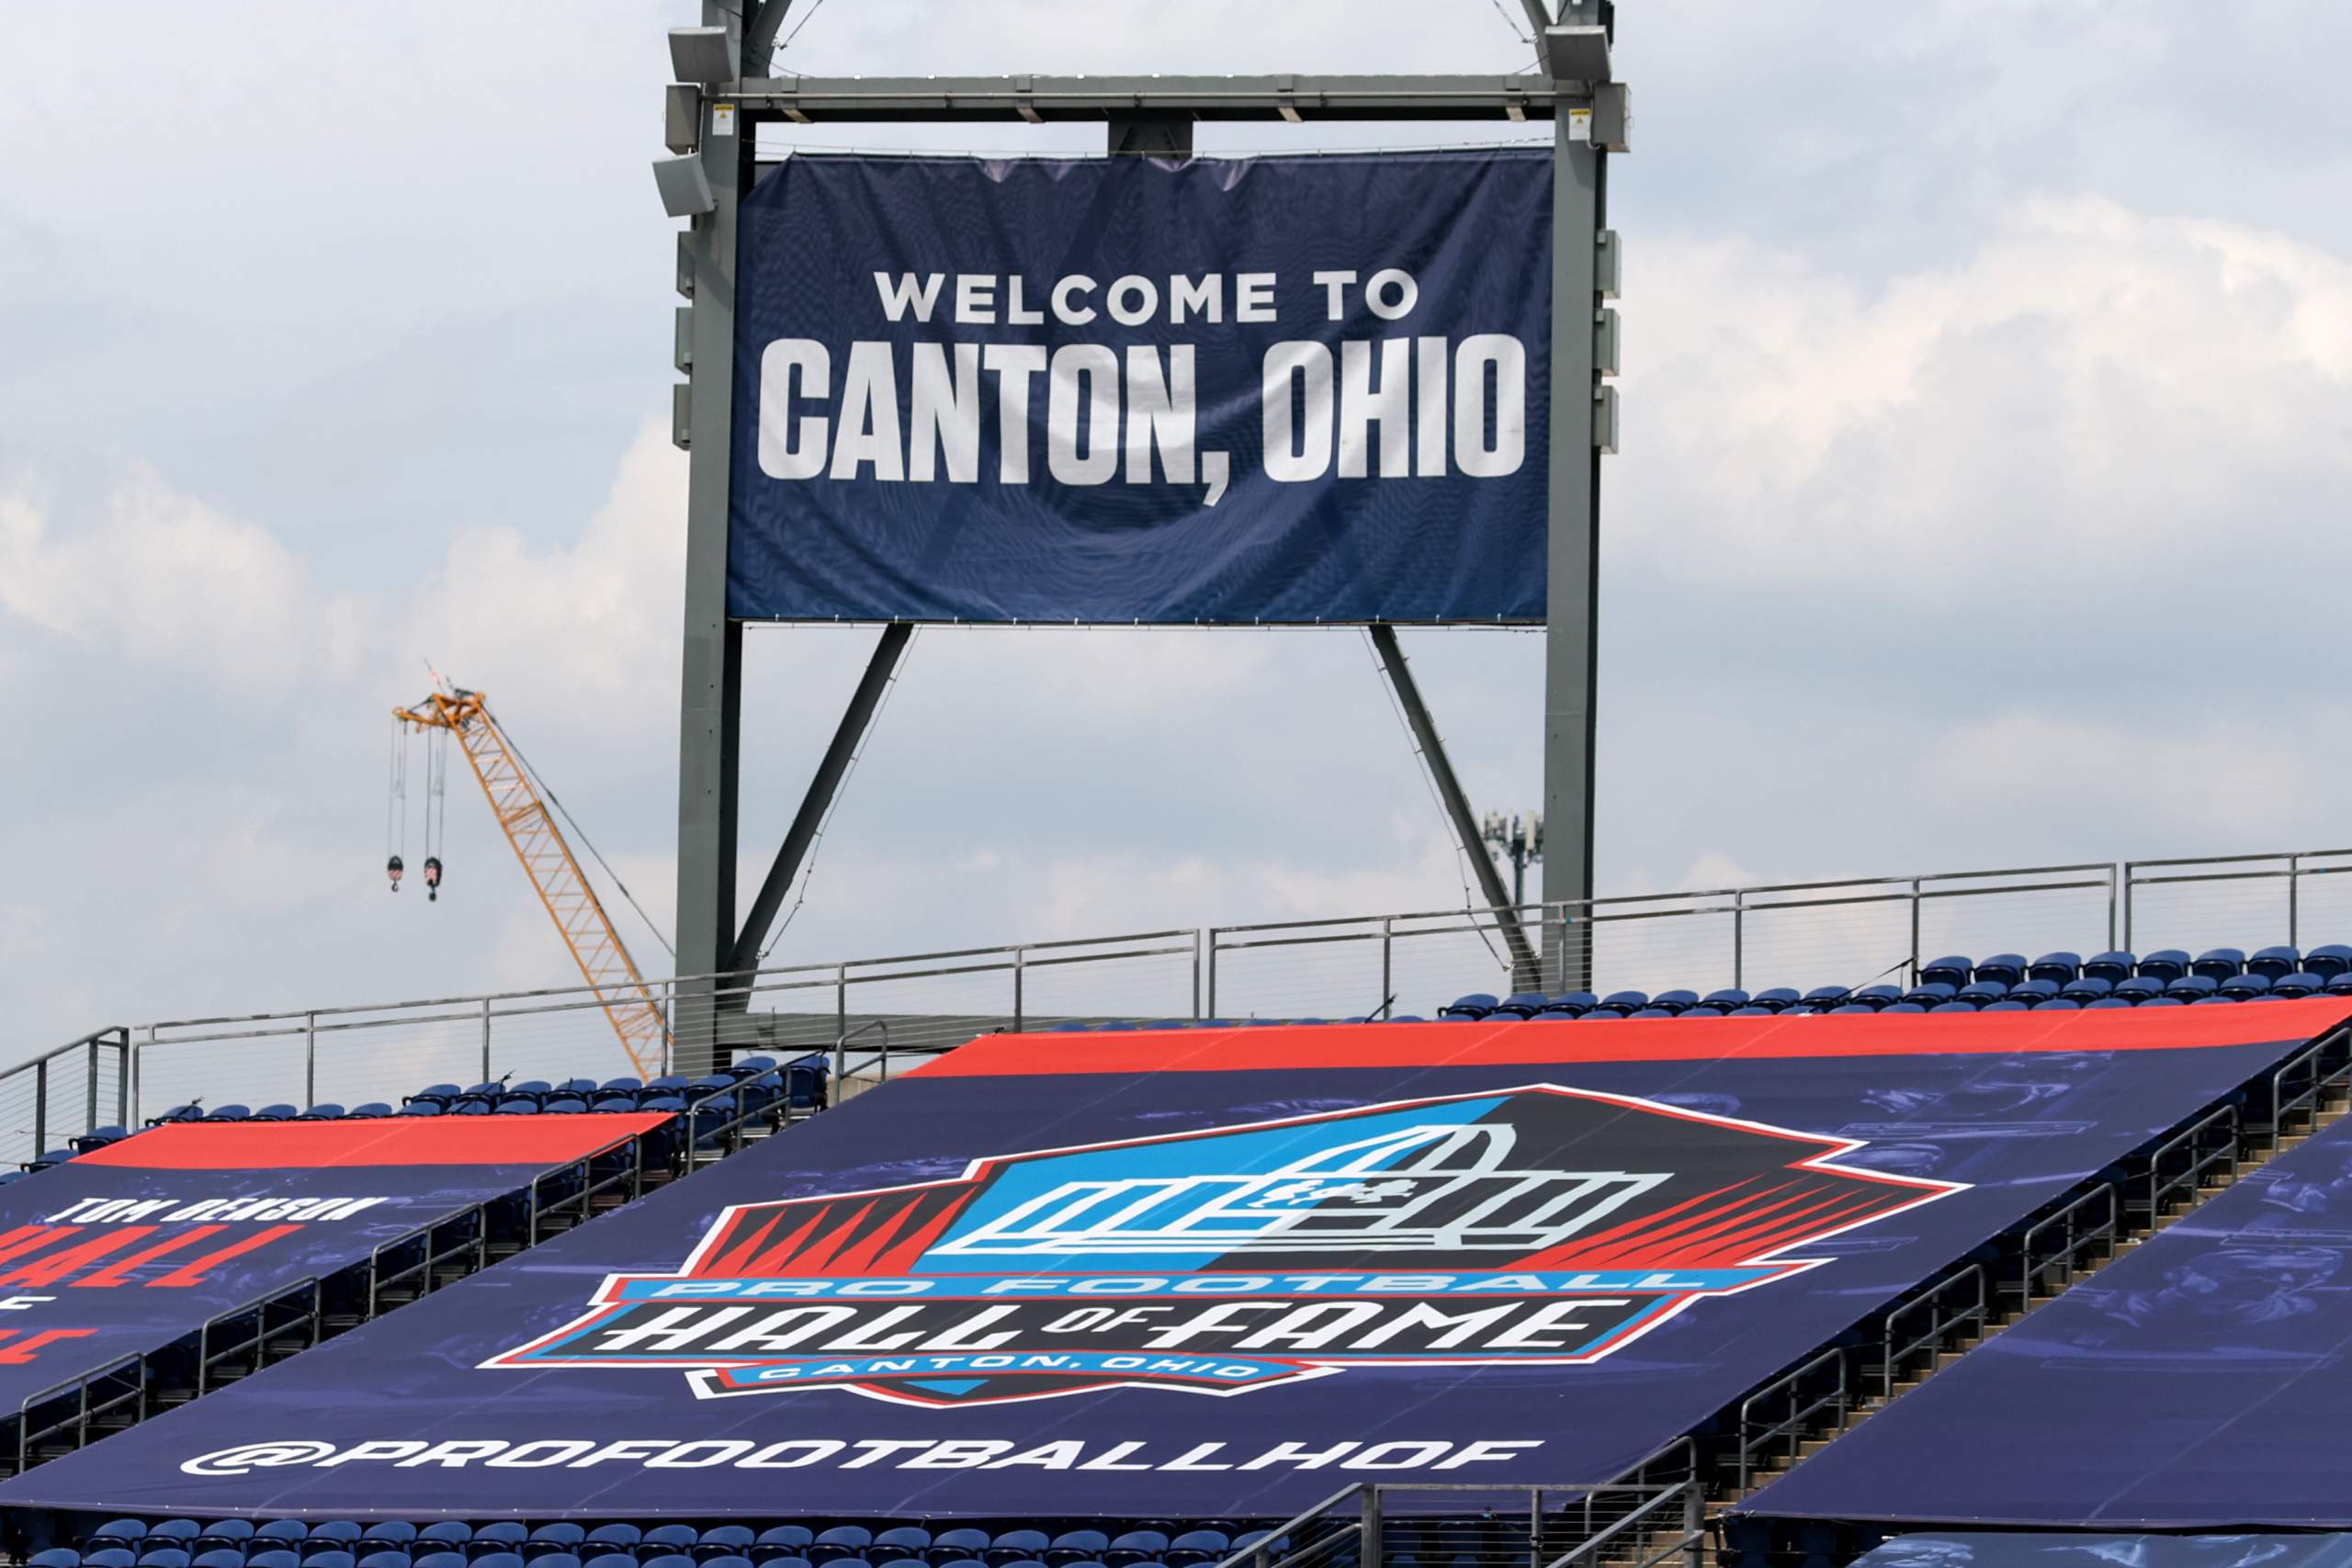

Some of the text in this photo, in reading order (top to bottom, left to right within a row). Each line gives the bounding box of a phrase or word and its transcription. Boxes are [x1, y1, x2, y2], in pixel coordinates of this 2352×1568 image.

[873, 268, 1419, 326] WELCOME TO
[757, 333, 1526, 508] CANTON, OHIO
[43, 1196, 390, 1224] TOM BENSON
[648, 1274, 1705, 1297] PRO FOOTBALL
[593, 1300, 1632, 1350] HALL OF FAME
[758, 1355, 1260, 1380] CANTON, OHIO
[179, 1438, 1546, 1477] @PROFOOTBALLHOF
